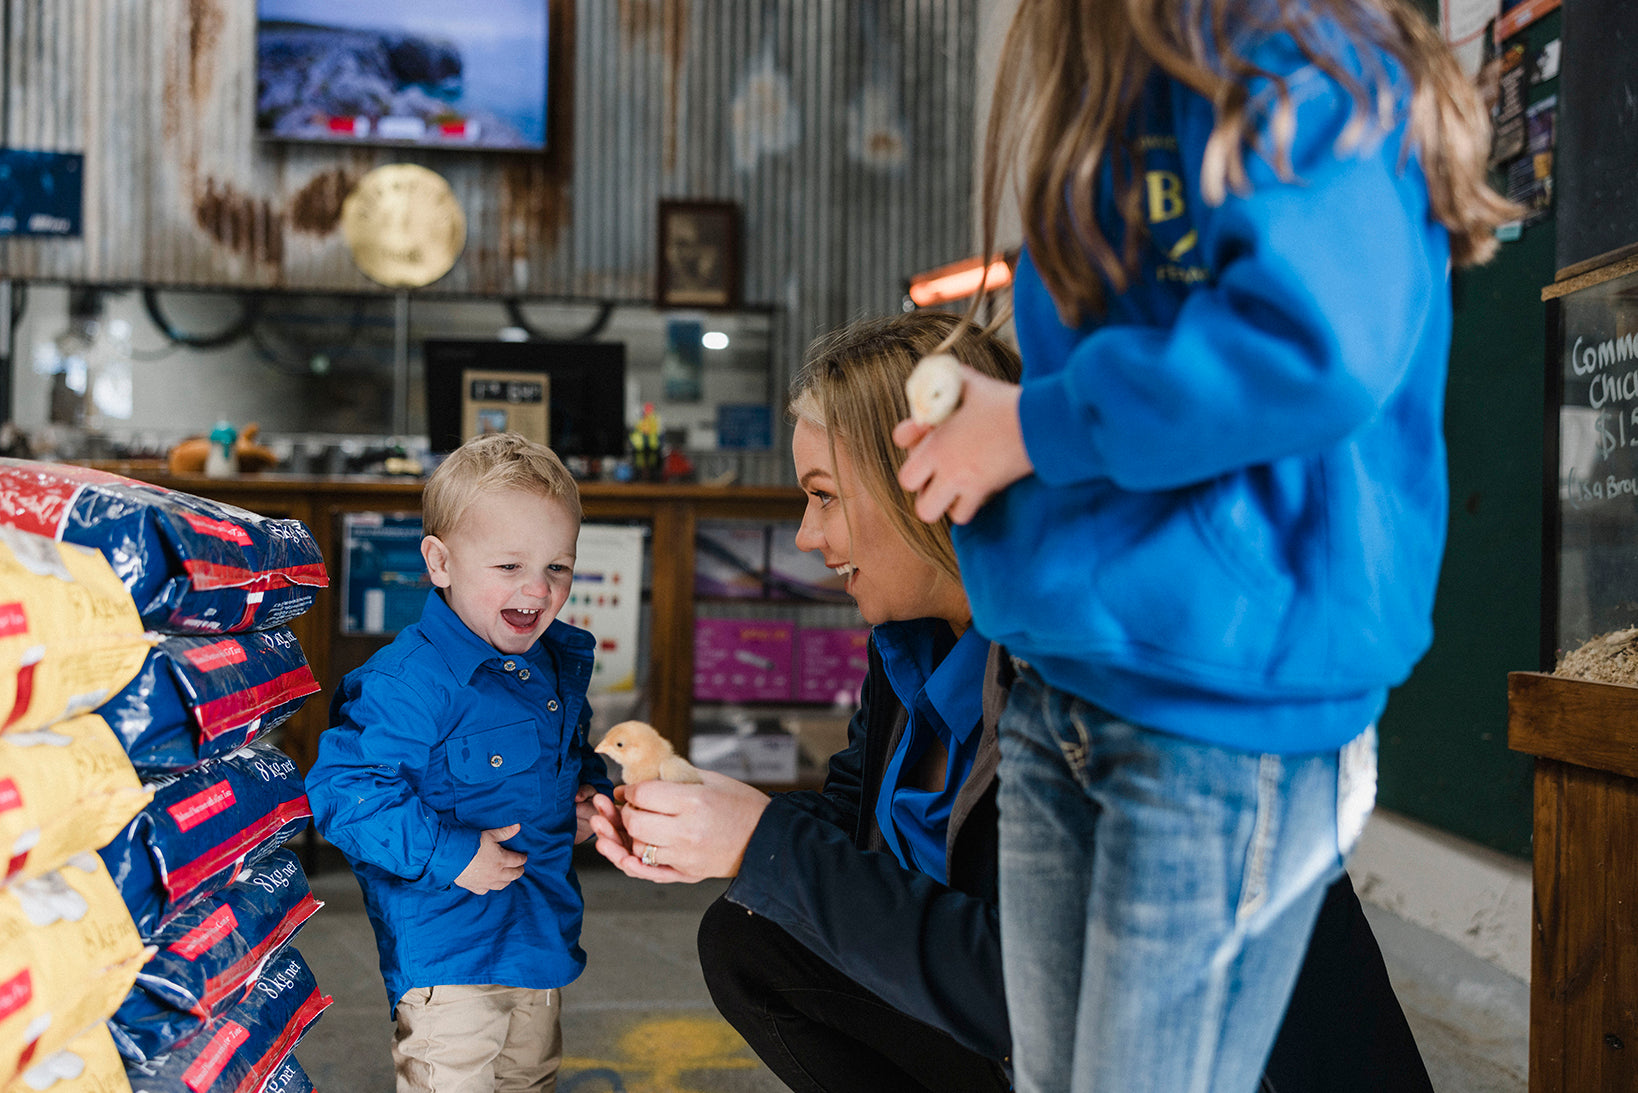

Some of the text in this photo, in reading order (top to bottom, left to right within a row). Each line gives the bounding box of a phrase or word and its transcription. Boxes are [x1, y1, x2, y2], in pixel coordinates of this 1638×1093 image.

[1146, 170, 1185, 224] B
[281, 759, 295, 774] net
[282, 861, 298, 877] net
[285, 961, 301, 978] net
[279, 1065, 296, 1085] net
